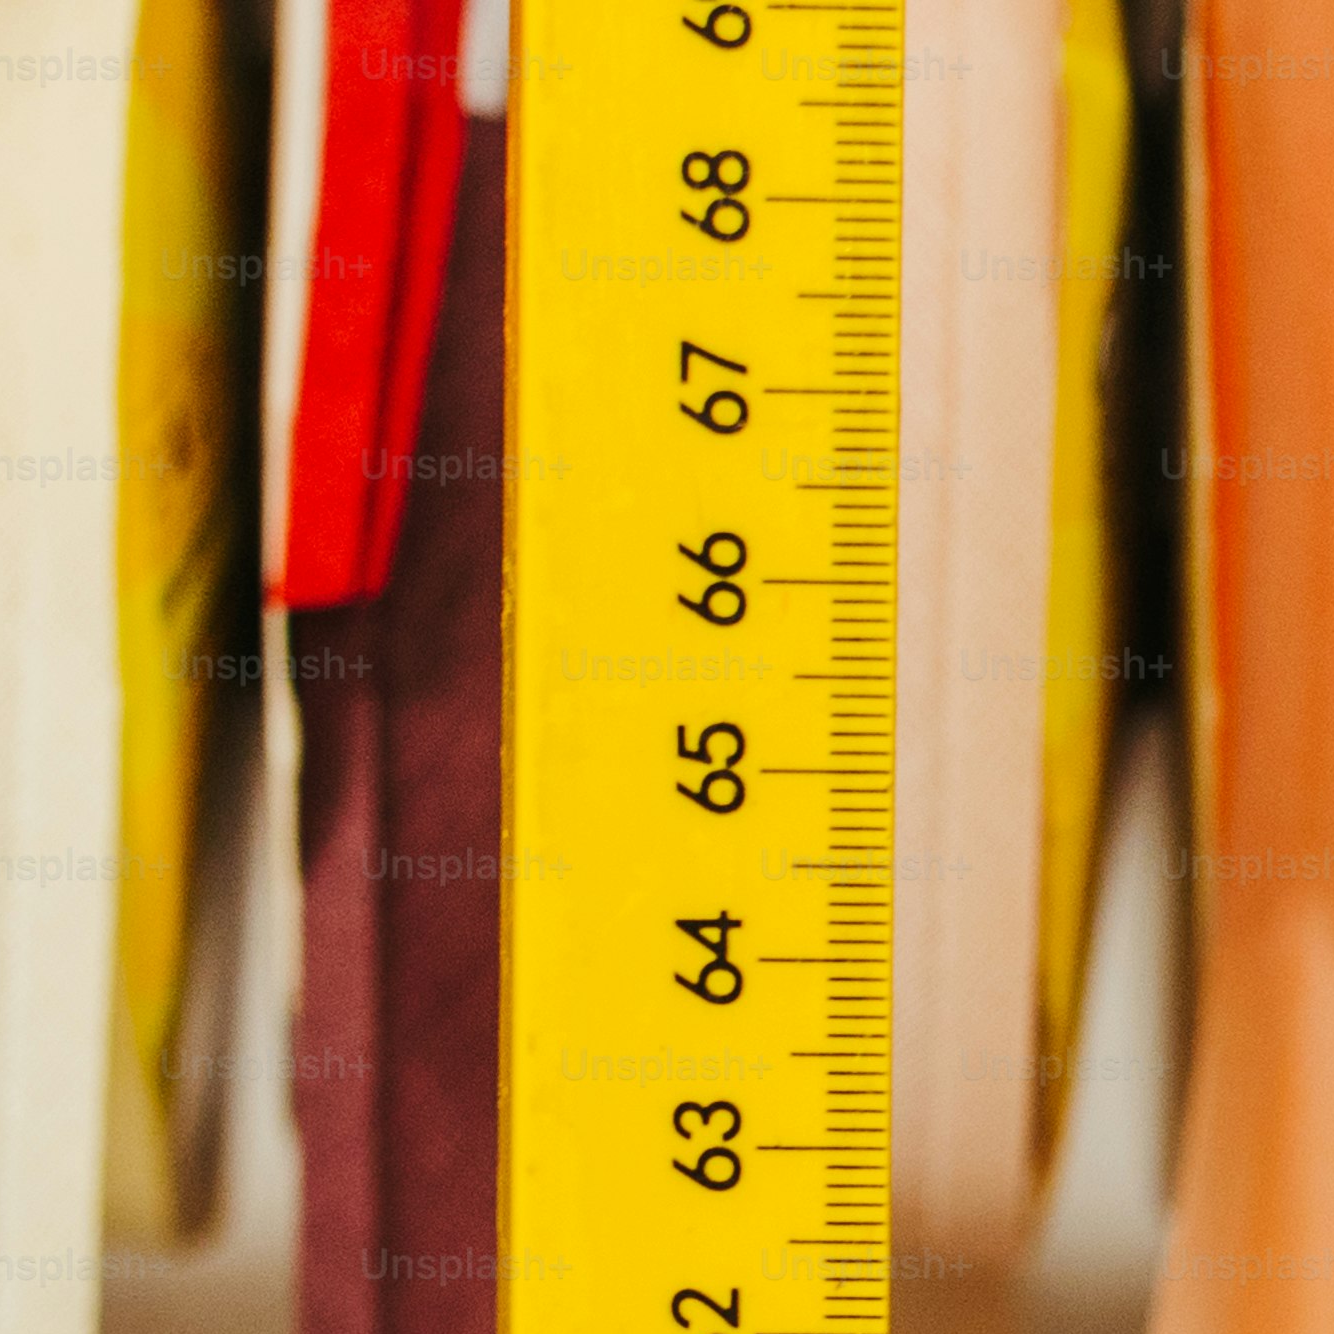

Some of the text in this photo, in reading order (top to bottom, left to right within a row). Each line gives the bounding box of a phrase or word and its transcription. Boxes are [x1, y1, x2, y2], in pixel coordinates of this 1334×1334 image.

[682, 0, 752, 50] 6
[680, 149, 750, 243] 68
[679, 340, 749, 435] 67
[677, 531, 747, 627] 66
[676, 721, 746, 815] 65
[674, 910, 743, 1005] 64
[672, 1100, 742, 1192] 63
